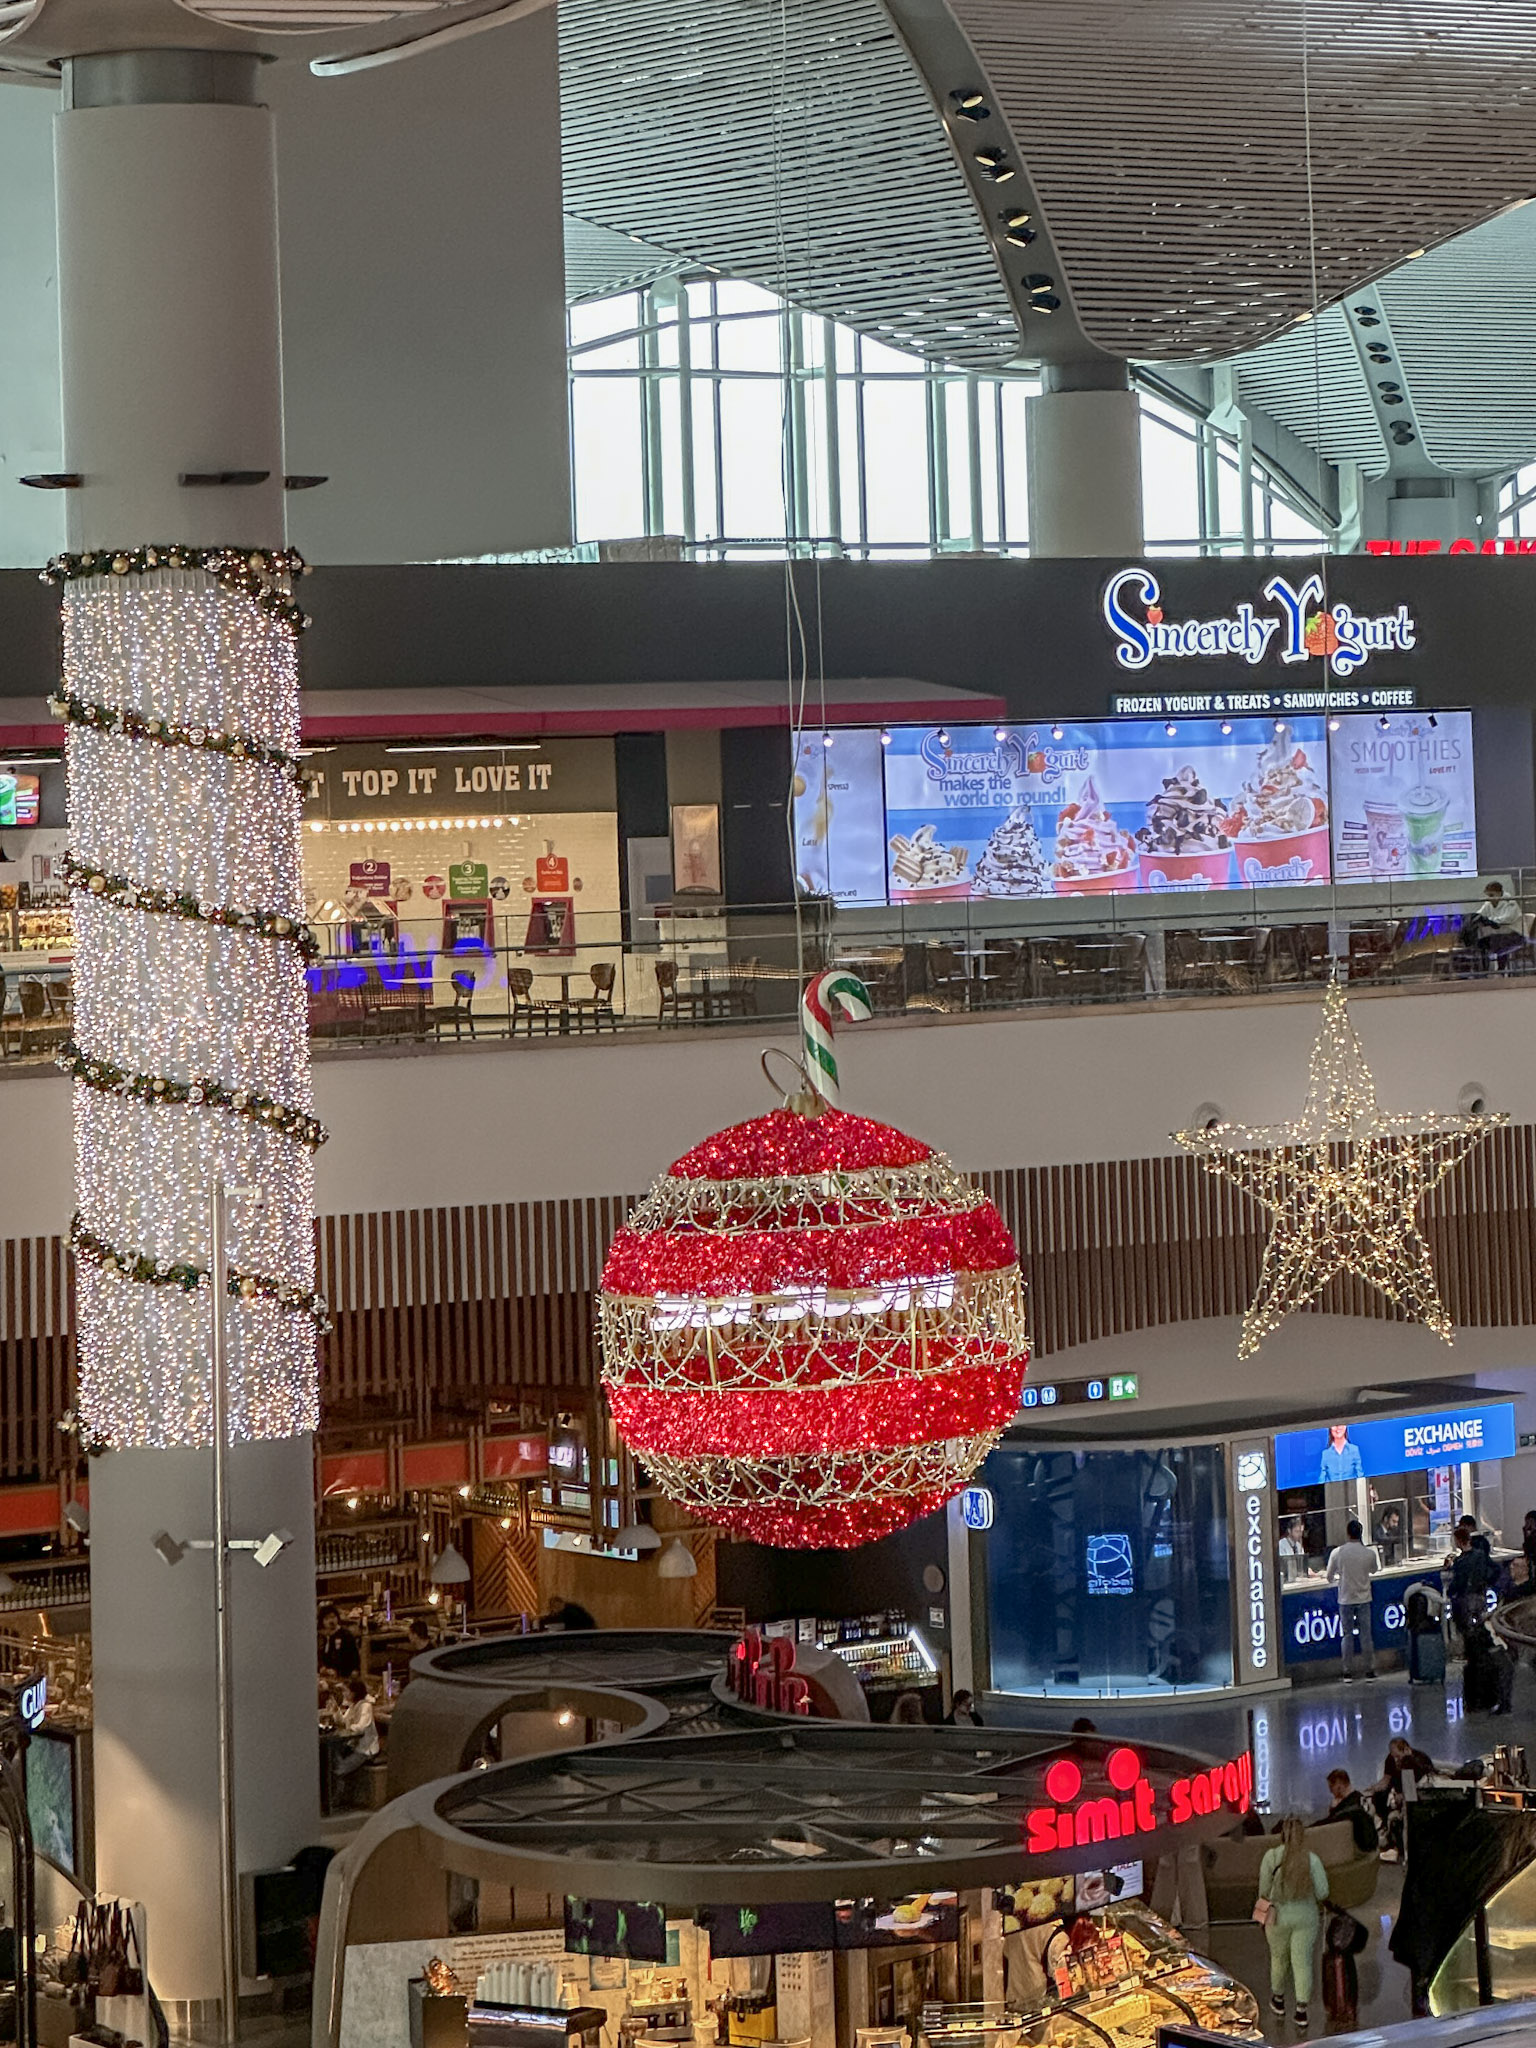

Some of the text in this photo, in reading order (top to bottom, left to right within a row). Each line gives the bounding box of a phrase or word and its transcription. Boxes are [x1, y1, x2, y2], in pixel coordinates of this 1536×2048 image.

[1104, 567, 1280, 669] Sincerely
[1116, 690, 1413, 713] FROZEN YOGURT & TREATS SANDWICHES COFFEE
[921, 729, 1016, 780] Sincerely
[1350, 739, 1461, 763] SMOOTHIES
[311, 764, 552, 798] T TOP IT LOVE IT
[939, 775, 1012, 791] makes the
[944, 786, 1066, 808] world go round!
[366, 862, 374, 872] 2
[464, 864, 472, 874] 3
[1404, 1418, 1483, 1447] EXCHANGE
[1246, 1495, 1267, 1668] exchange
[1027, 1748, 1156, 1853] simit
